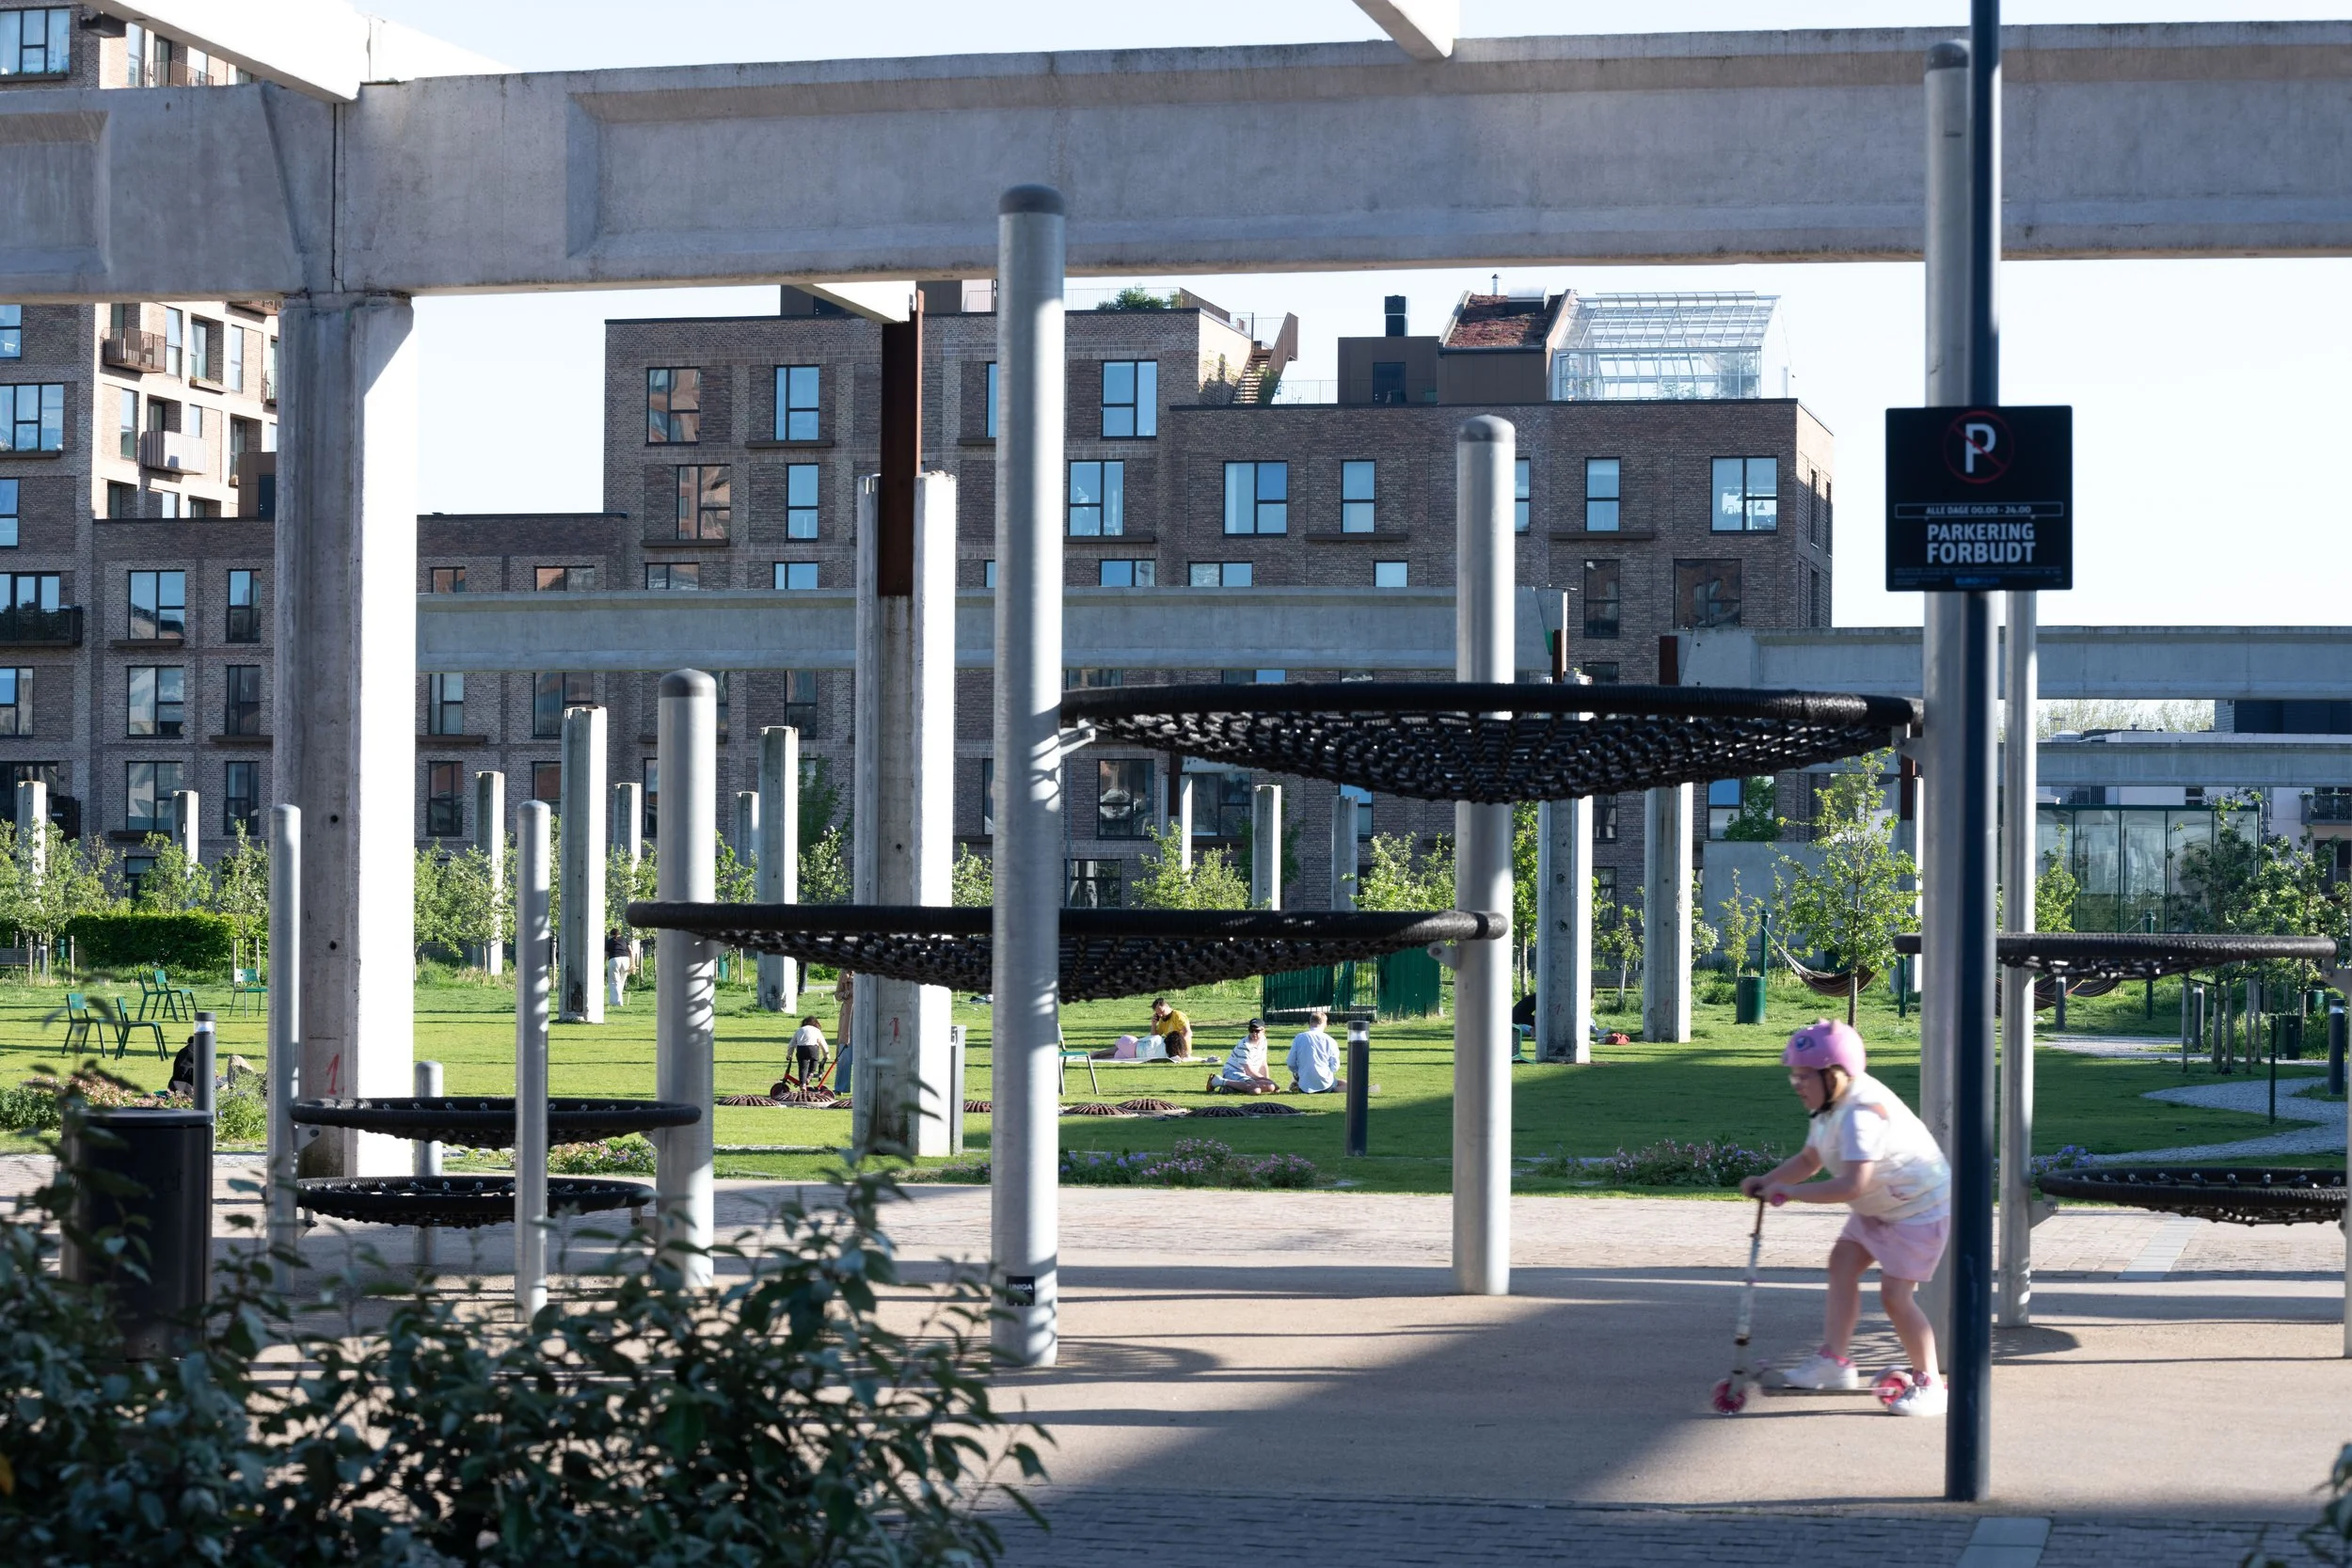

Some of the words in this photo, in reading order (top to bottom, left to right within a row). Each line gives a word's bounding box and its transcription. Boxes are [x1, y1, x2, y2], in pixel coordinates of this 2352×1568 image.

[1965, 423, 1996, 473] P
[1926, 505, 1946, 515] ALLE
[1947, 505, 1969, 515] DAGE
[1970, 505, 1998, 515] 00.00
[2005, 504, 2032, 514] 24.00
[1927, 522, 2035, 541] PARKERING
[1927, 541, 2036, 564] FORBUDT
